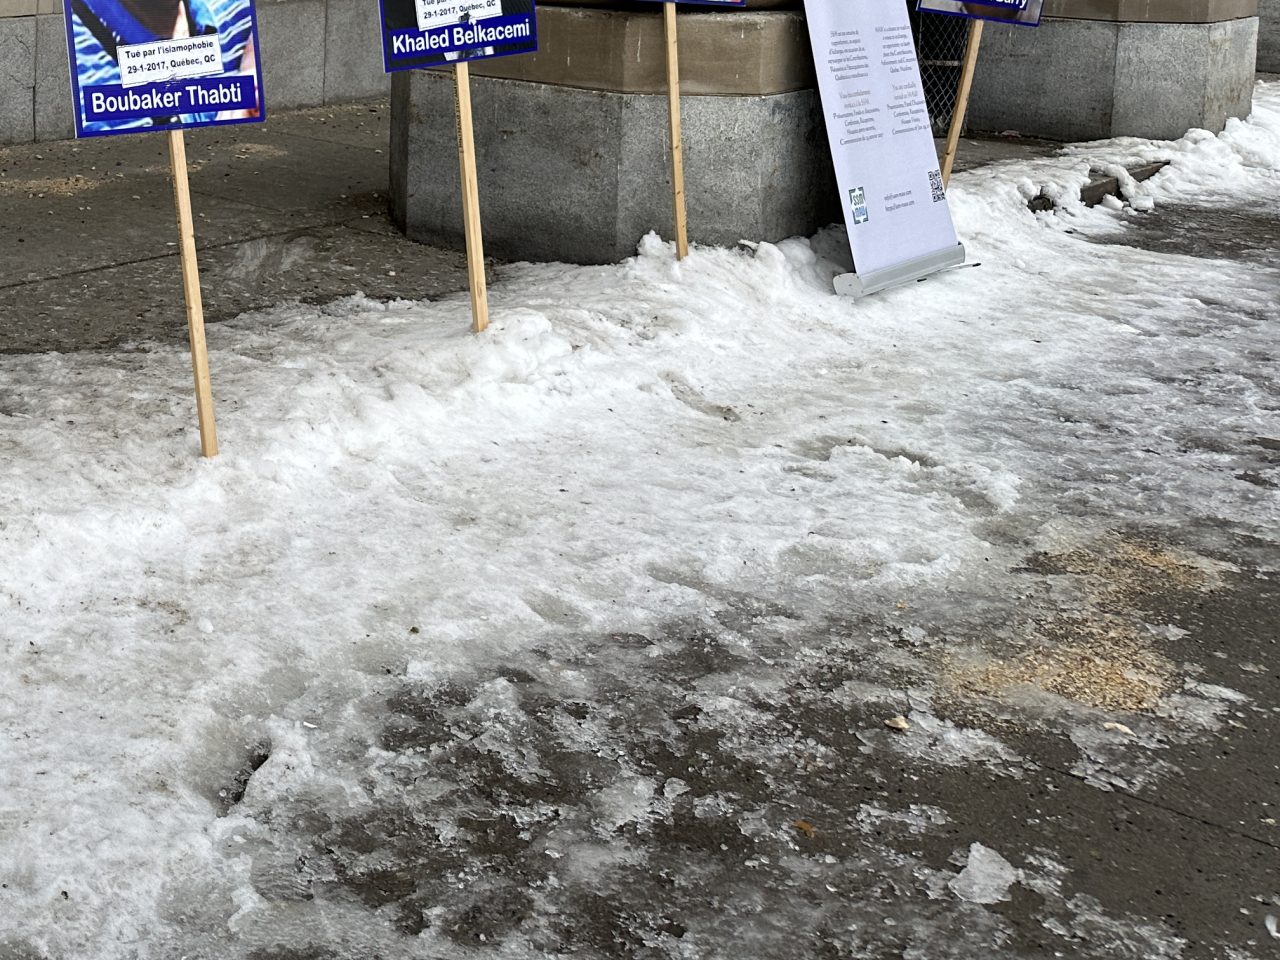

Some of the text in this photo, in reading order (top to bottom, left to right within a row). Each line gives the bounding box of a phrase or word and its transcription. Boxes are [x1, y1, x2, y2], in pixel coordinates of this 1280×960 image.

[423, 7, 458, 19] 29-1-2017,
[486, 0, 496, 8] QC
[392, 19, 530, 54] Khaled Belkacemi
[125, 40, 214, 59] Tué par l'islamophobie
[127, 54, 216, 74] 29-1-2017, Québec, QC
[92, 83, 242, 113] Boubaker Thabti
